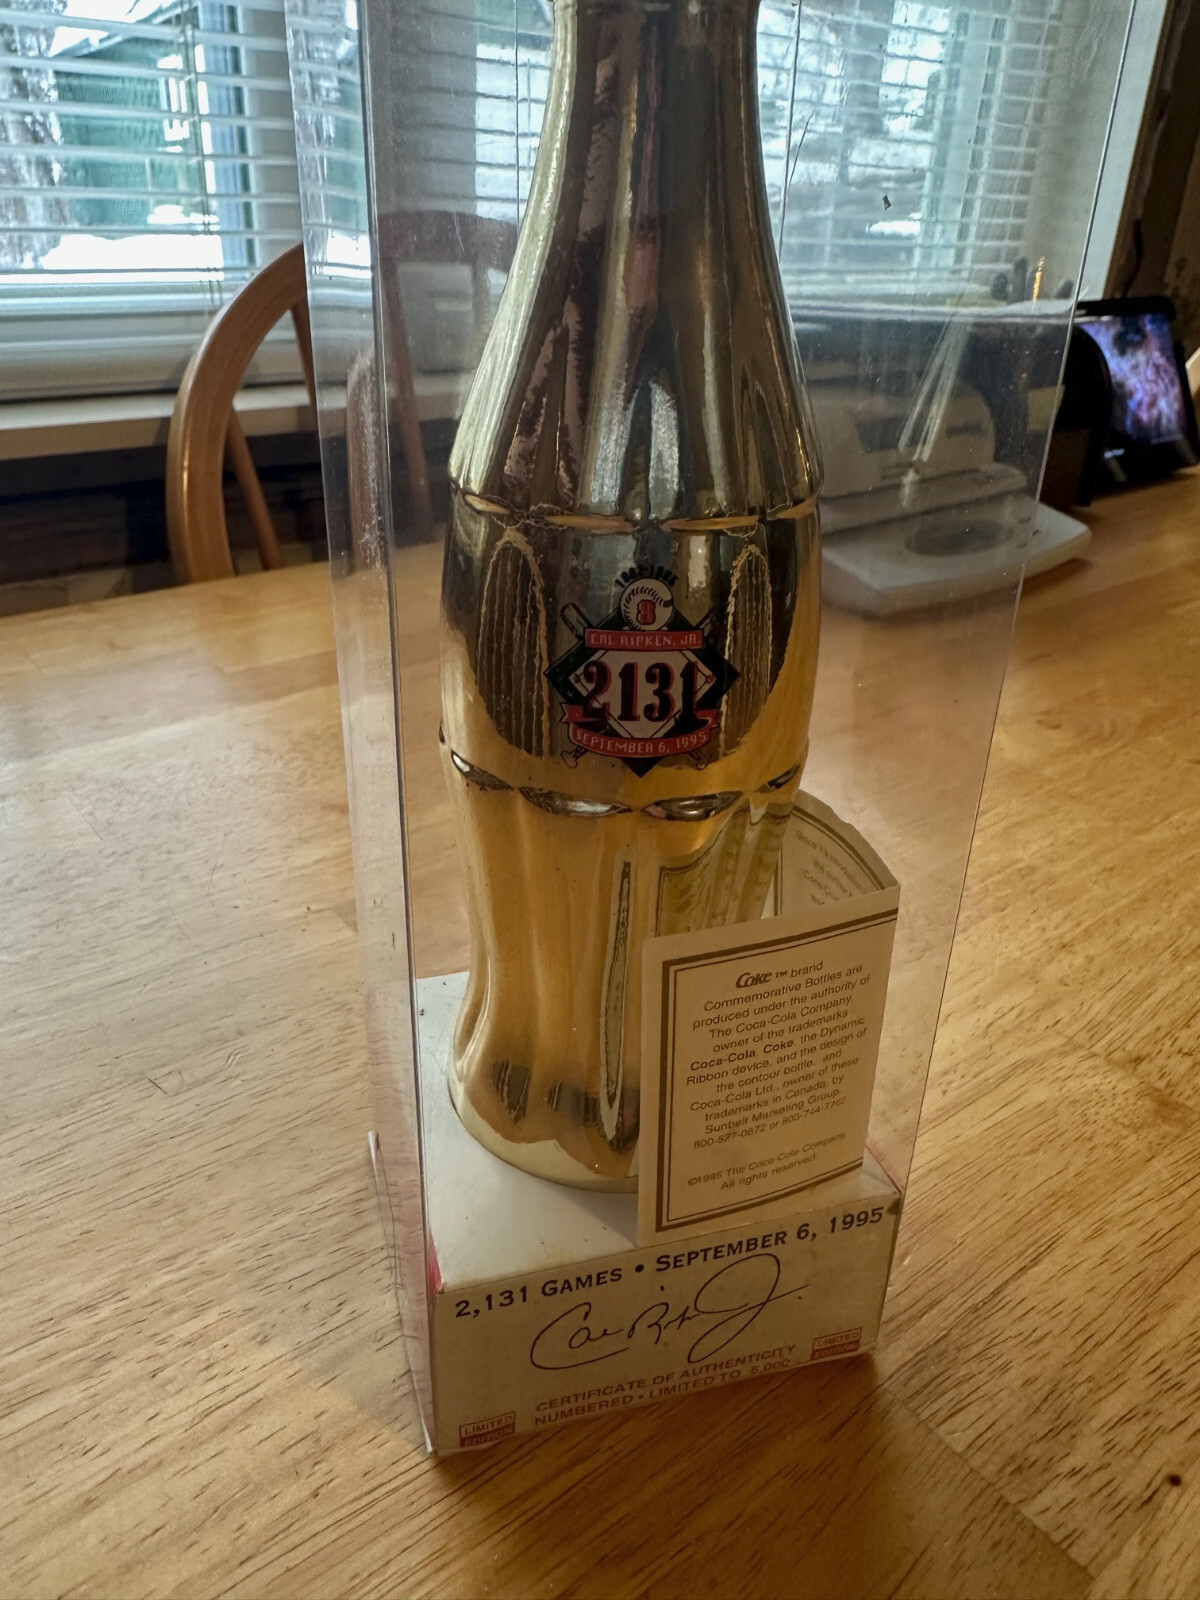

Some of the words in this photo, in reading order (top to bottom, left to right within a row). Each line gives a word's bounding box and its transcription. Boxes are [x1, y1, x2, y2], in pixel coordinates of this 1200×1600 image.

[636, 599, 657, 625] 8
[590, 633, 614, 646] CAL
[620, 633, 677, 647] RIPKEN,
[582, 660, 699, 723] 2131
[574, 729, 655, 754] SEPTEMBER
[676, 731, 708, 750] 1995
[704, 983, 802, 1012] Commemorative
[805, 970, 842, 989] Bottles
[846, 964, 863, 977] are
[735, 972, 773, 989] Coke
[790, 961, 824, 978] brand
[692, 1007, 749, 1031] produced
[753, 1001, 787, 1016] under
[790, 995, 807, 1007] the
[810, 979, 858, 1000] authority
[860, 974, 871, 986] of
[709, 1028, 732, 1039] The
[736, 1013, 797, 1034] Coca-Cola
[713, 1038, 749, 1053] owner
[753, 1031, 765, 1043] of
[767, 1027, 785, 1040] the
[788, 1010, 849, 1034] trademarks
[800, 1032, 818, 1044] the
[820, 1016, 866, 1038] Dynamic
[686, 1069, 729, 1086] Ribbon
[776, 1052, 798, 1065] and
[800, 1046, 817, 1058] the
[820, 1033, 854, 1052] design
[856, 1028, 867, 1039] of
[716, 1081, 735, 1093] the
[738, 1069, 781, 1088] contour
[822, 1049, 842, 1063] and
[690, 1091, 752, 1112] Coca-Cola
[783, 1073, 816, 1089] owner
[818, 1065, 829, 1077] of
[831, 1057, 860, 1072] these
[705, 1098, 769, 1122] trademarks
[772, 1095, 782, 1104] in
[832, 1074, 845, 1086] by
[693, 1123, 766, 1149] 800-527-0672
[769, 1121, 780, 1130] or
[705, 1117, 749, 1135] Sunbelt
[752, 1100, 805, 1123] Marketing
[720, 1179, 736, 1190] All
[738, 1170, 768, 1186] rights
[725, 1166, 745, 1177] The
[455, 1286, 528, 1319] 2,131
[541, 1268, 623, 1297] GAMES
[656, 1230, 788, 1272] SEPTEMBER
[796, 1223, 817, 1242] 6,
[830, 1207, 885, 1234] 1995
[535, 1378, 648, 1412] CERTIFICATE
[652, 1373, 676, 1386] OF
[679, 1344, 797, 1379] AUTHENTICITY
[535, 1395, 634, 1427] NUMBERED
[650, 1376, 716, 1399] LIMITED
[720, 1369, 742, 1382] TO
[464, 1415, 513, 1435] LIMITED
